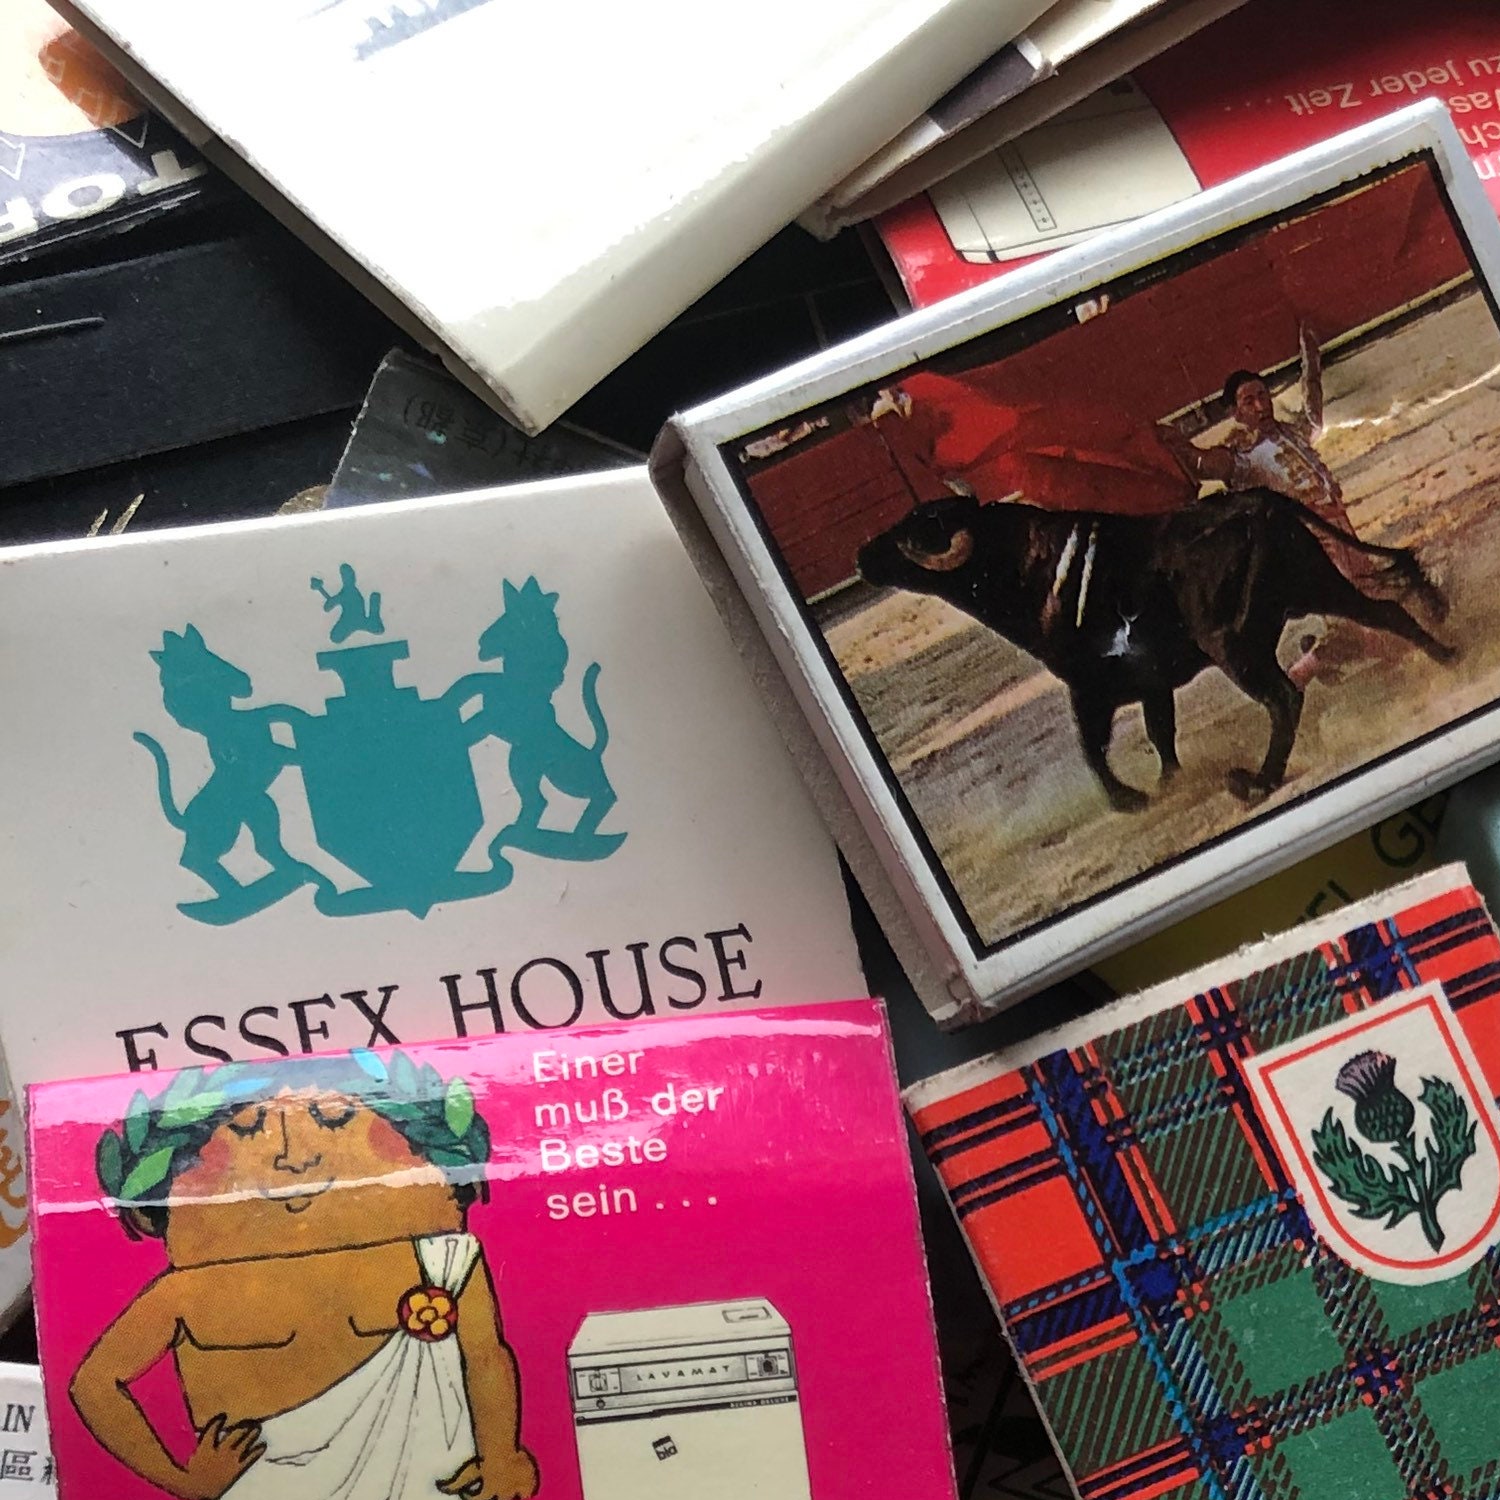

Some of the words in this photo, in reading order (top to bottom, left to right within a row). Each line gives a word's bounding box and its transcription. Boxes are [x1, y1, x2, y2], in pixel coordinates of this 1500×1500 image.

[1284, 81, 1362, 117] Zeit
[1369, 60, 1460, 99] jeder
[440, 923, 763, 1043] HOUSE
[532, 1045, 644, 1083] Einer
[534, 1090, 630, 1128] muß
[651, 1083, 724, 1116] der
[540, 1133, 668, 1172] Beste
[547, 1185, 638, 1220] sein
